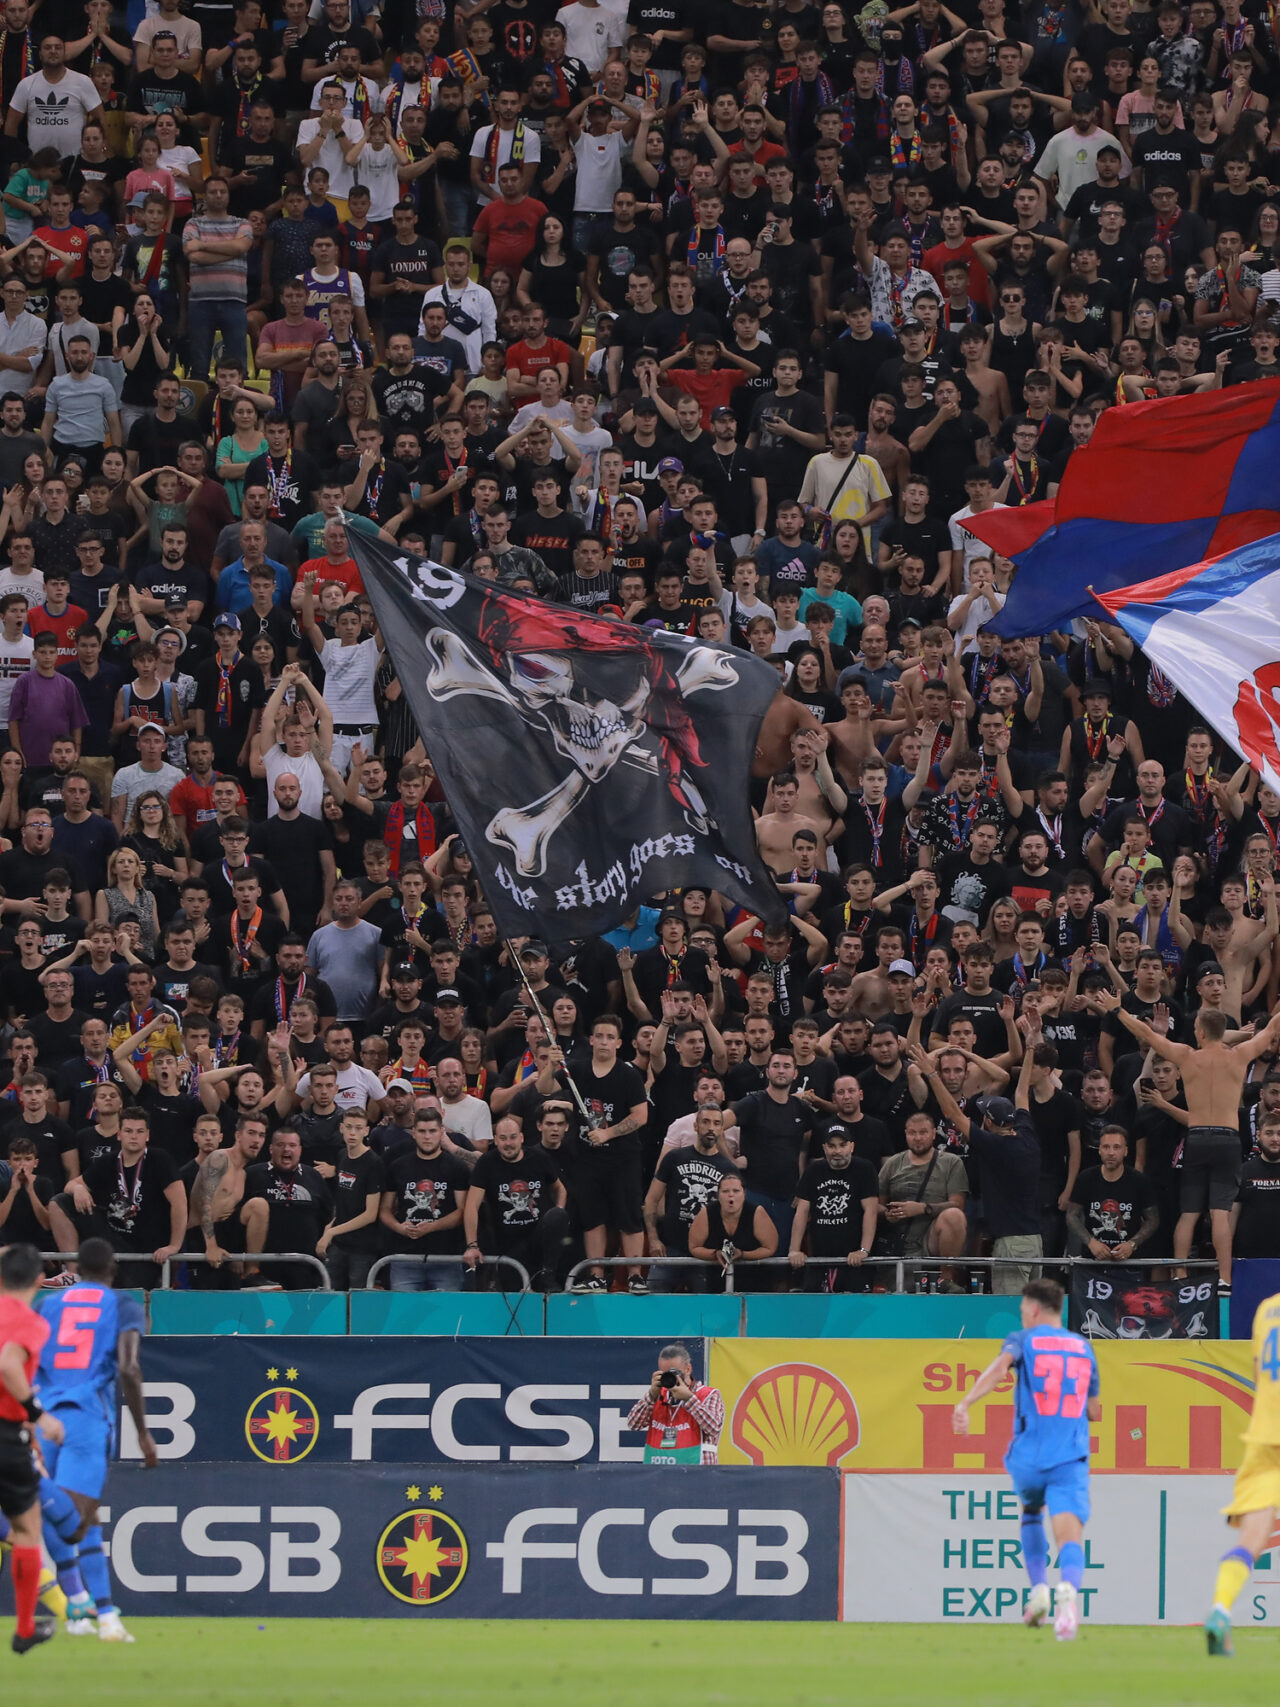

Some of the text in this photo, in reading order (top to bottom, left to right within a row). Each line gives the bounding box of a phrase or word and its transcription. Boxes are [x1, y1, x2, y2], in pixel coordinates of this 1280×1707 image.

[641, 8, 675, 19] adidas
[35, 116, 69, 126] adidas
[1144, 151, 1181, 162] adidas
[390, 261, 427, 273] LONDON
[526, 534, 569, 549] DIESEL
[612, 559, 627, 567] UCK
[776, 570, 807, 581] adida
[151, 584, 187, 594] adidas
[57, 647, 78, 656] TANO
[555, 858, 629, 911] story
[630, 832, 696, 889] goes
[342, 1091, 356, 1099] NIKE
[676, 1163, 724, 1183] HEADRUS
[406, 1182, 447, 1190] 19 96
[499, 1180, 541, 1192] 19 96
[1089, 1201, 1132, 1212] 19 96
[816, 1217, 848, 1225] ATHLETES
[1085, 1278, 1212, 1304] 19 96
[54, 1307, 102, 1370] 5
[922, 1363, 1014, 1393] She
[942, 1489, 1020, 1520] THE
[98, 1506, 341, 1593] CSB
[486, 1507, 810, 1597] FCSB
[943, 1539, 1105, 1569] HERL
[943, 1587, 1098, 1617] EXPT
